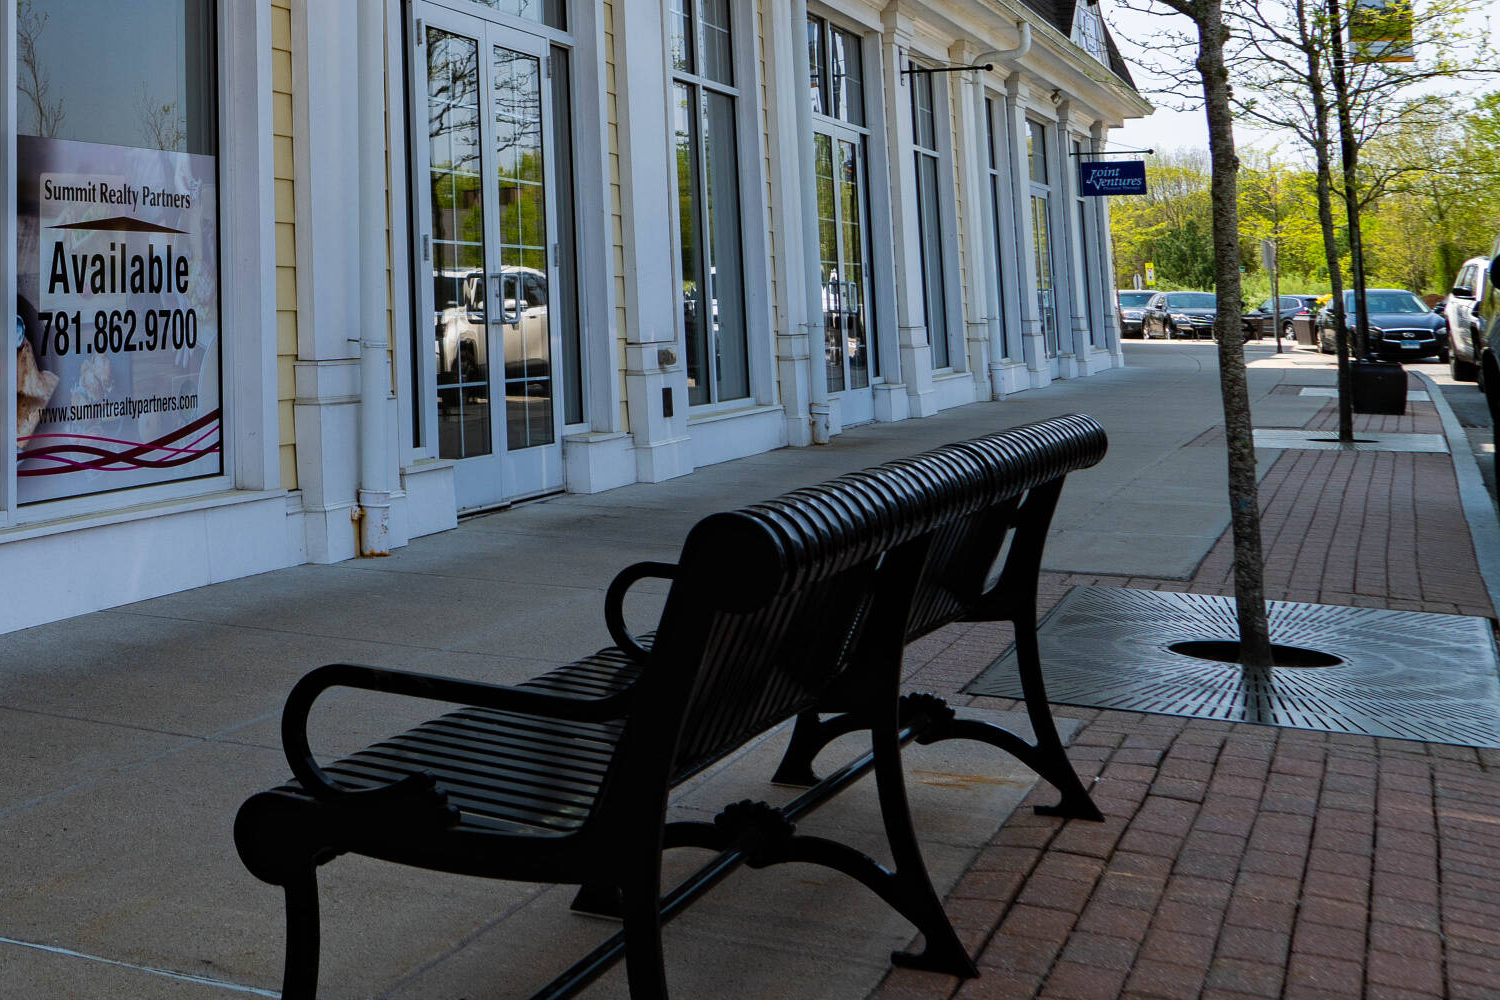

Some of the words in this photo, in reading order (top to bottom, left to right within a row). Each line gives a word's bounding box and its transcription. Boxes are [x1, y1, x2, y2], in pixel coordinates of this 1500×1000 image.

[1086, 167, 1120, 183] Joint
[1092, 177, 1143, 190] Ventures
[44, 179, 97, 203] Summit
[99, 182, 139, 212] Realty
[142, 185, 191, 209] Partners
[48, 241, 189, 294] Available
[37, 309, 198, 357] 781.862.9700
[38, 393, 199, 424] www.summitrealtypartners.com
